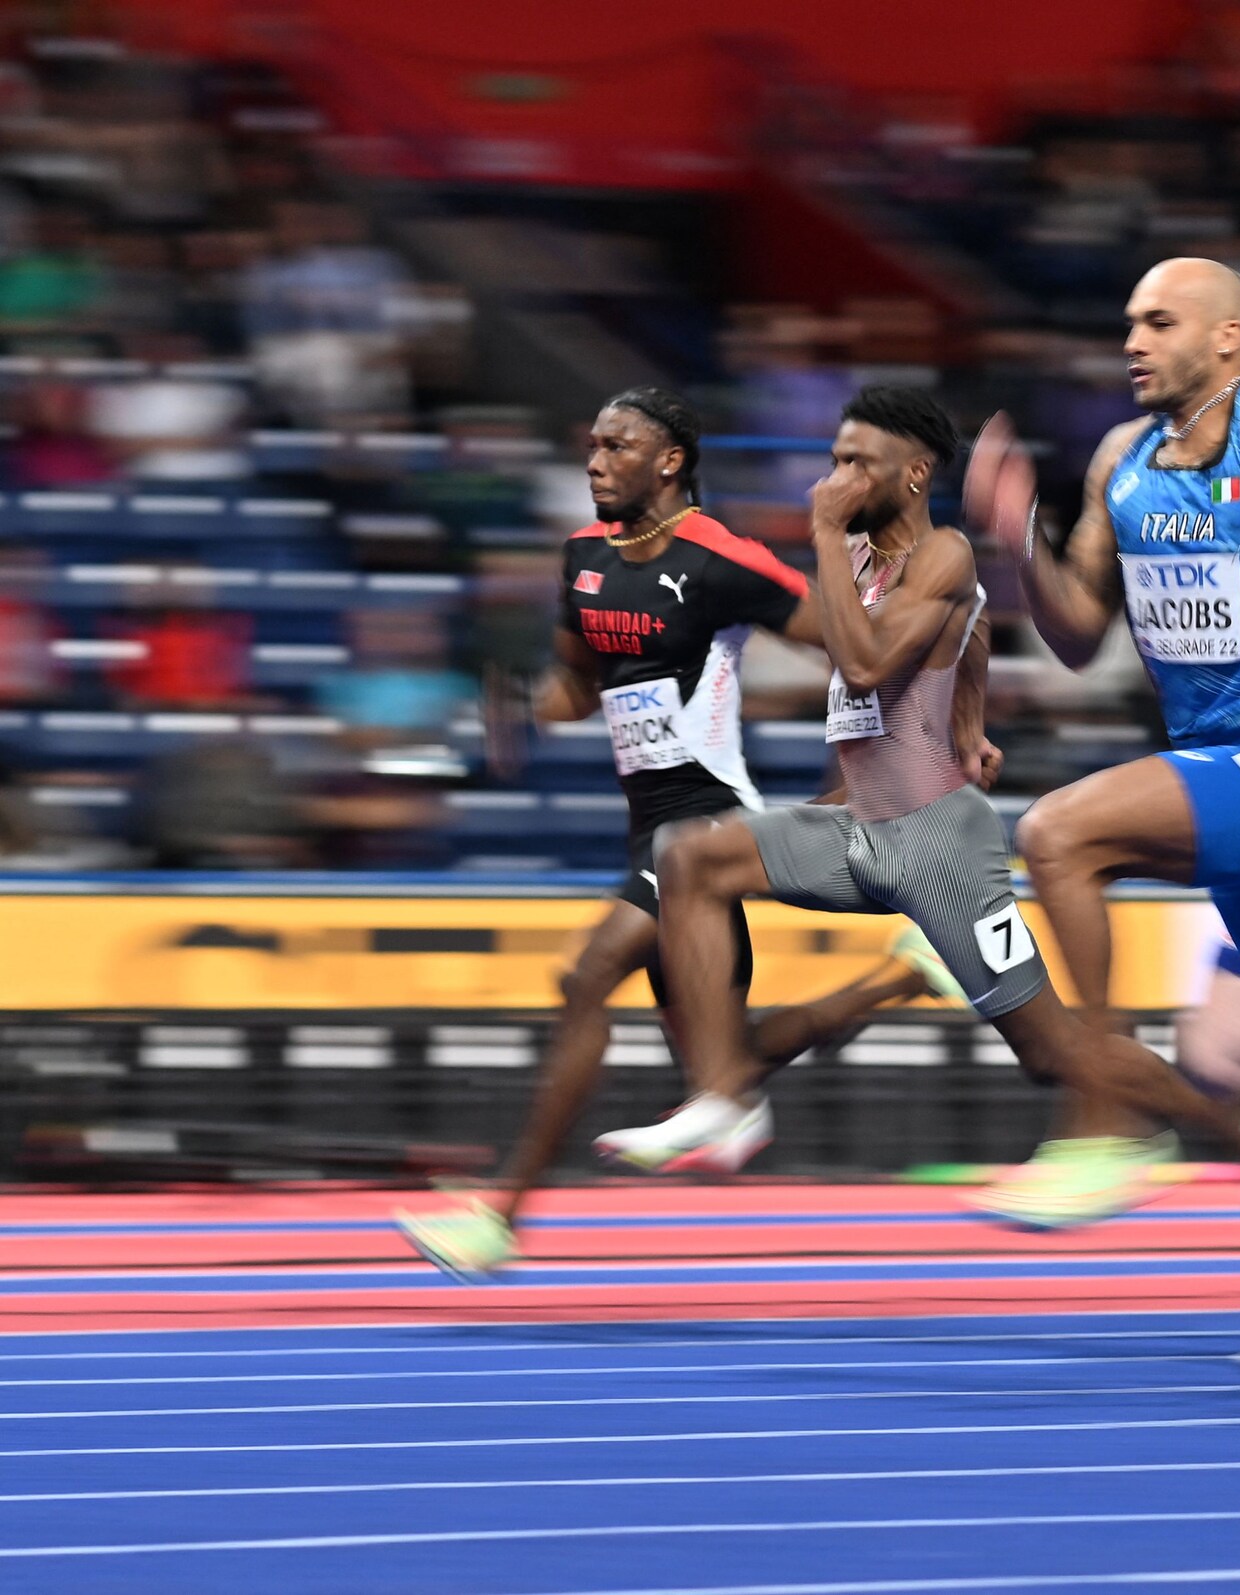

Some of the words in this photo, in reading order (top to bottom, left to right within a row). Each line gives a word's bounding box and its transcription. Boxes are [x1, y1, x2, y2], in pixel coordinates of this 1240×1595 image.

[1140, 512, 1216, 544] ITALIA
[1150, 561, 1220, 588] TDK
[1136, 598, 1232, 630] JACOBS
[1218, 638, 1238, 656] 22
[612, 686, 664, 713] TDK
[863, 716, 879, 731] 22
[991, 917, 1012, 961] 7
